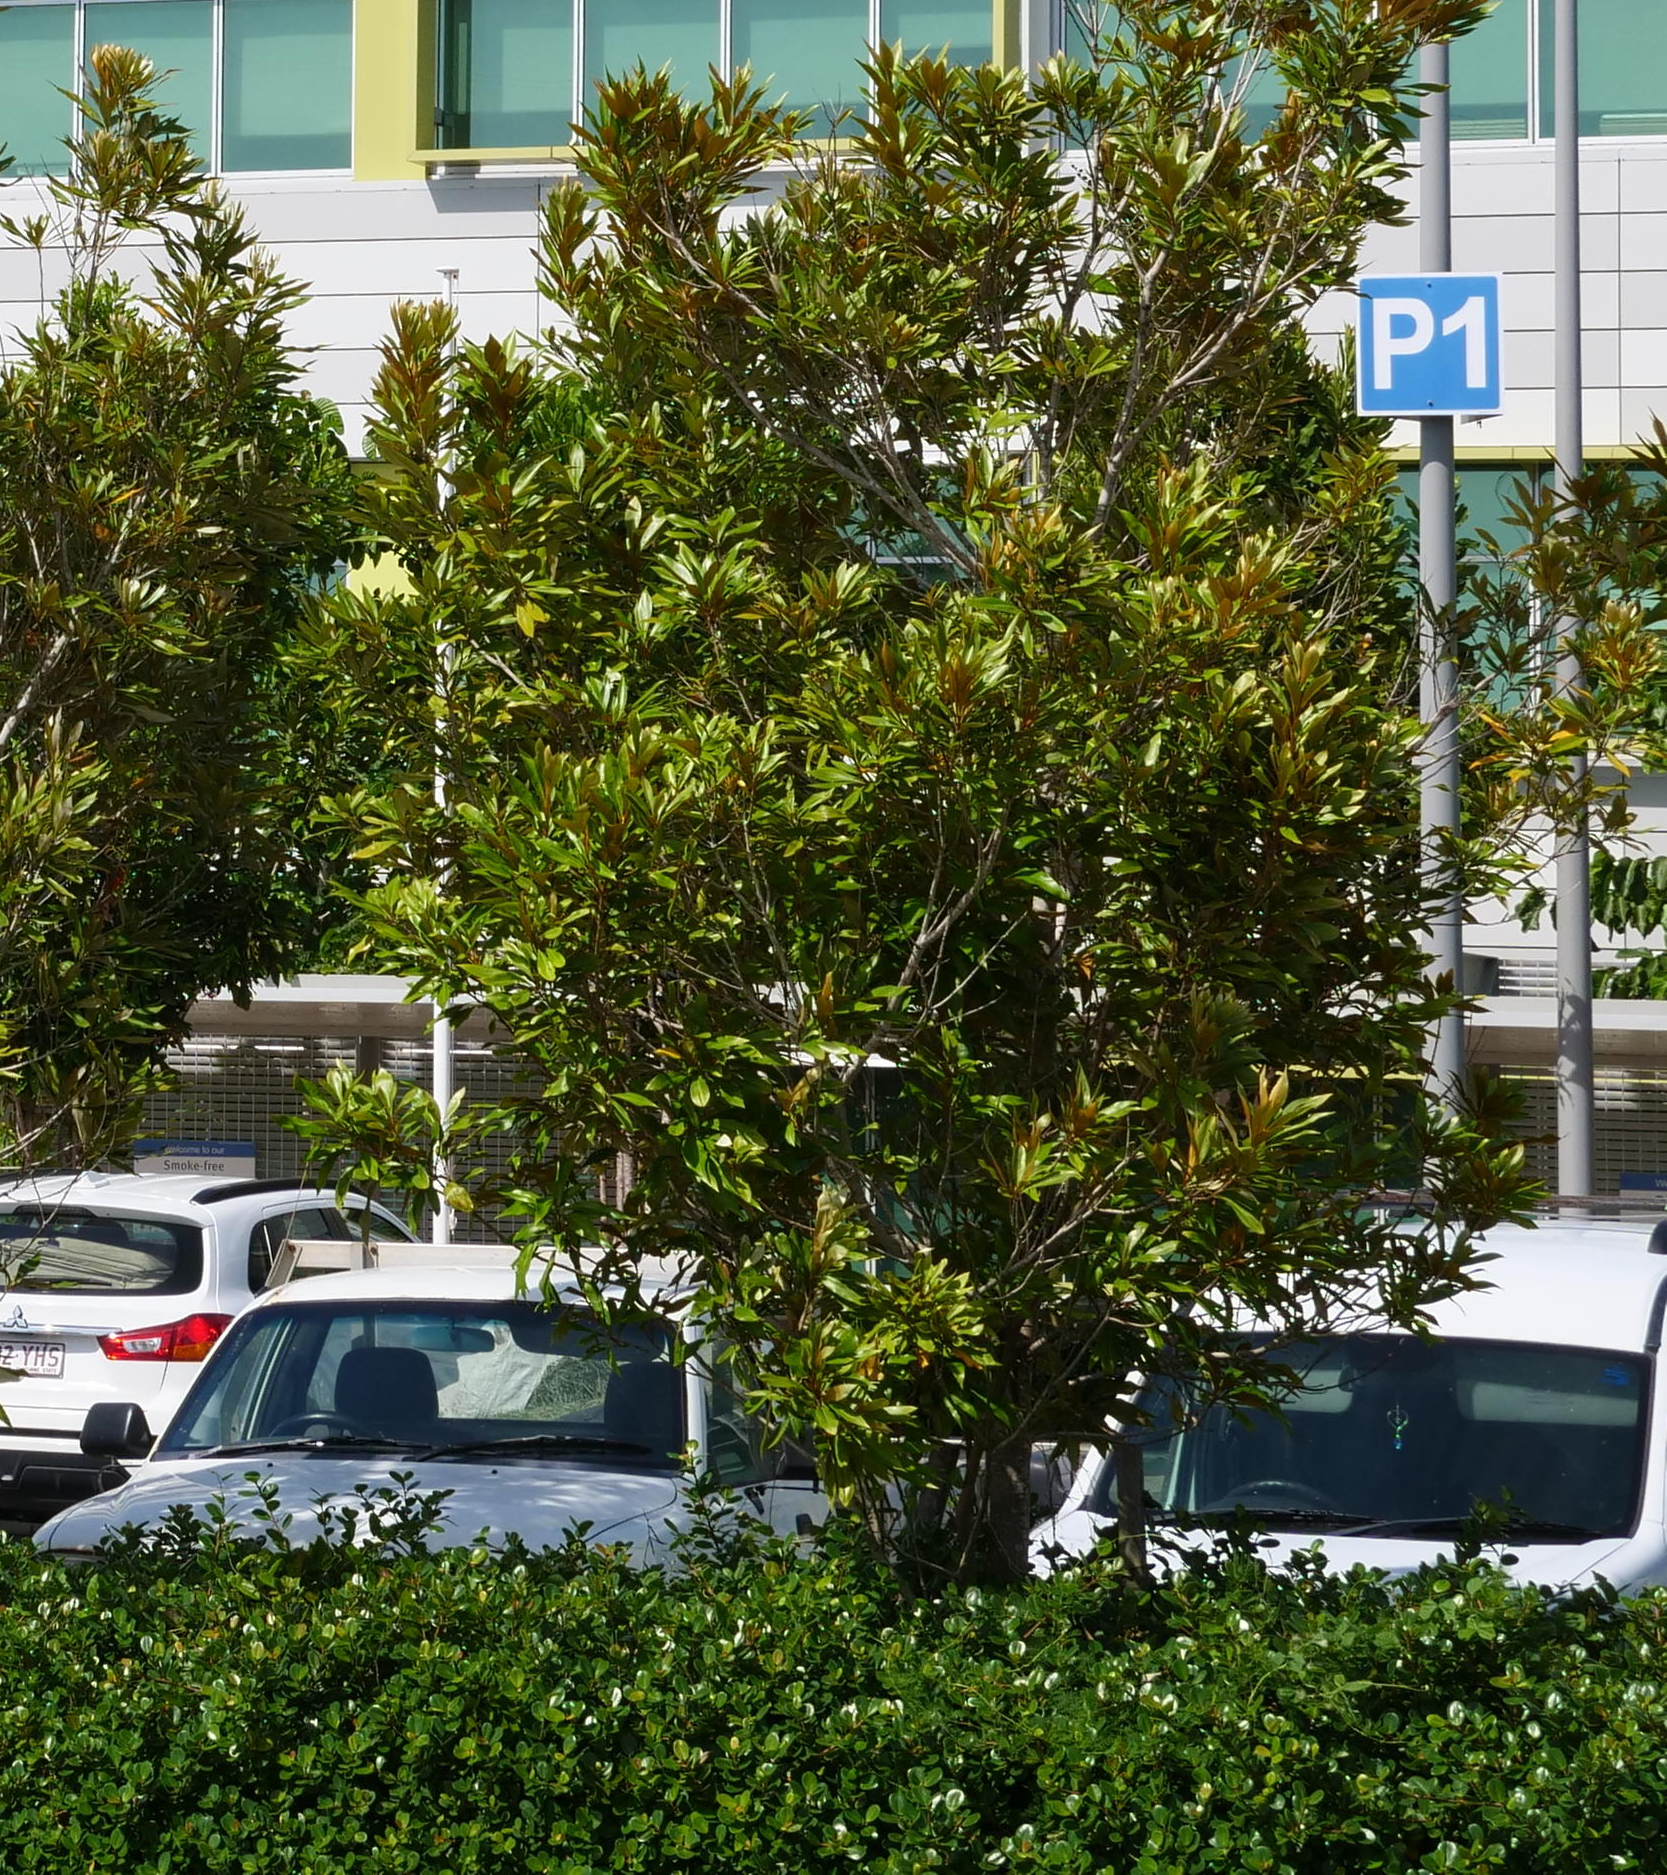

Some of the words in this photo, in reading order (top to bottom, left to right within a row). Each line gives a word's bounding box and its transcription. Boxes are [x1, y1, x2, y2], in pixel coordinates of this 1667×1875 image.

[1372, 296, 1487, 390] P1
[202, 1146, 210, 1154] to
[163, 1159, 225, 1171] Smoke-free
